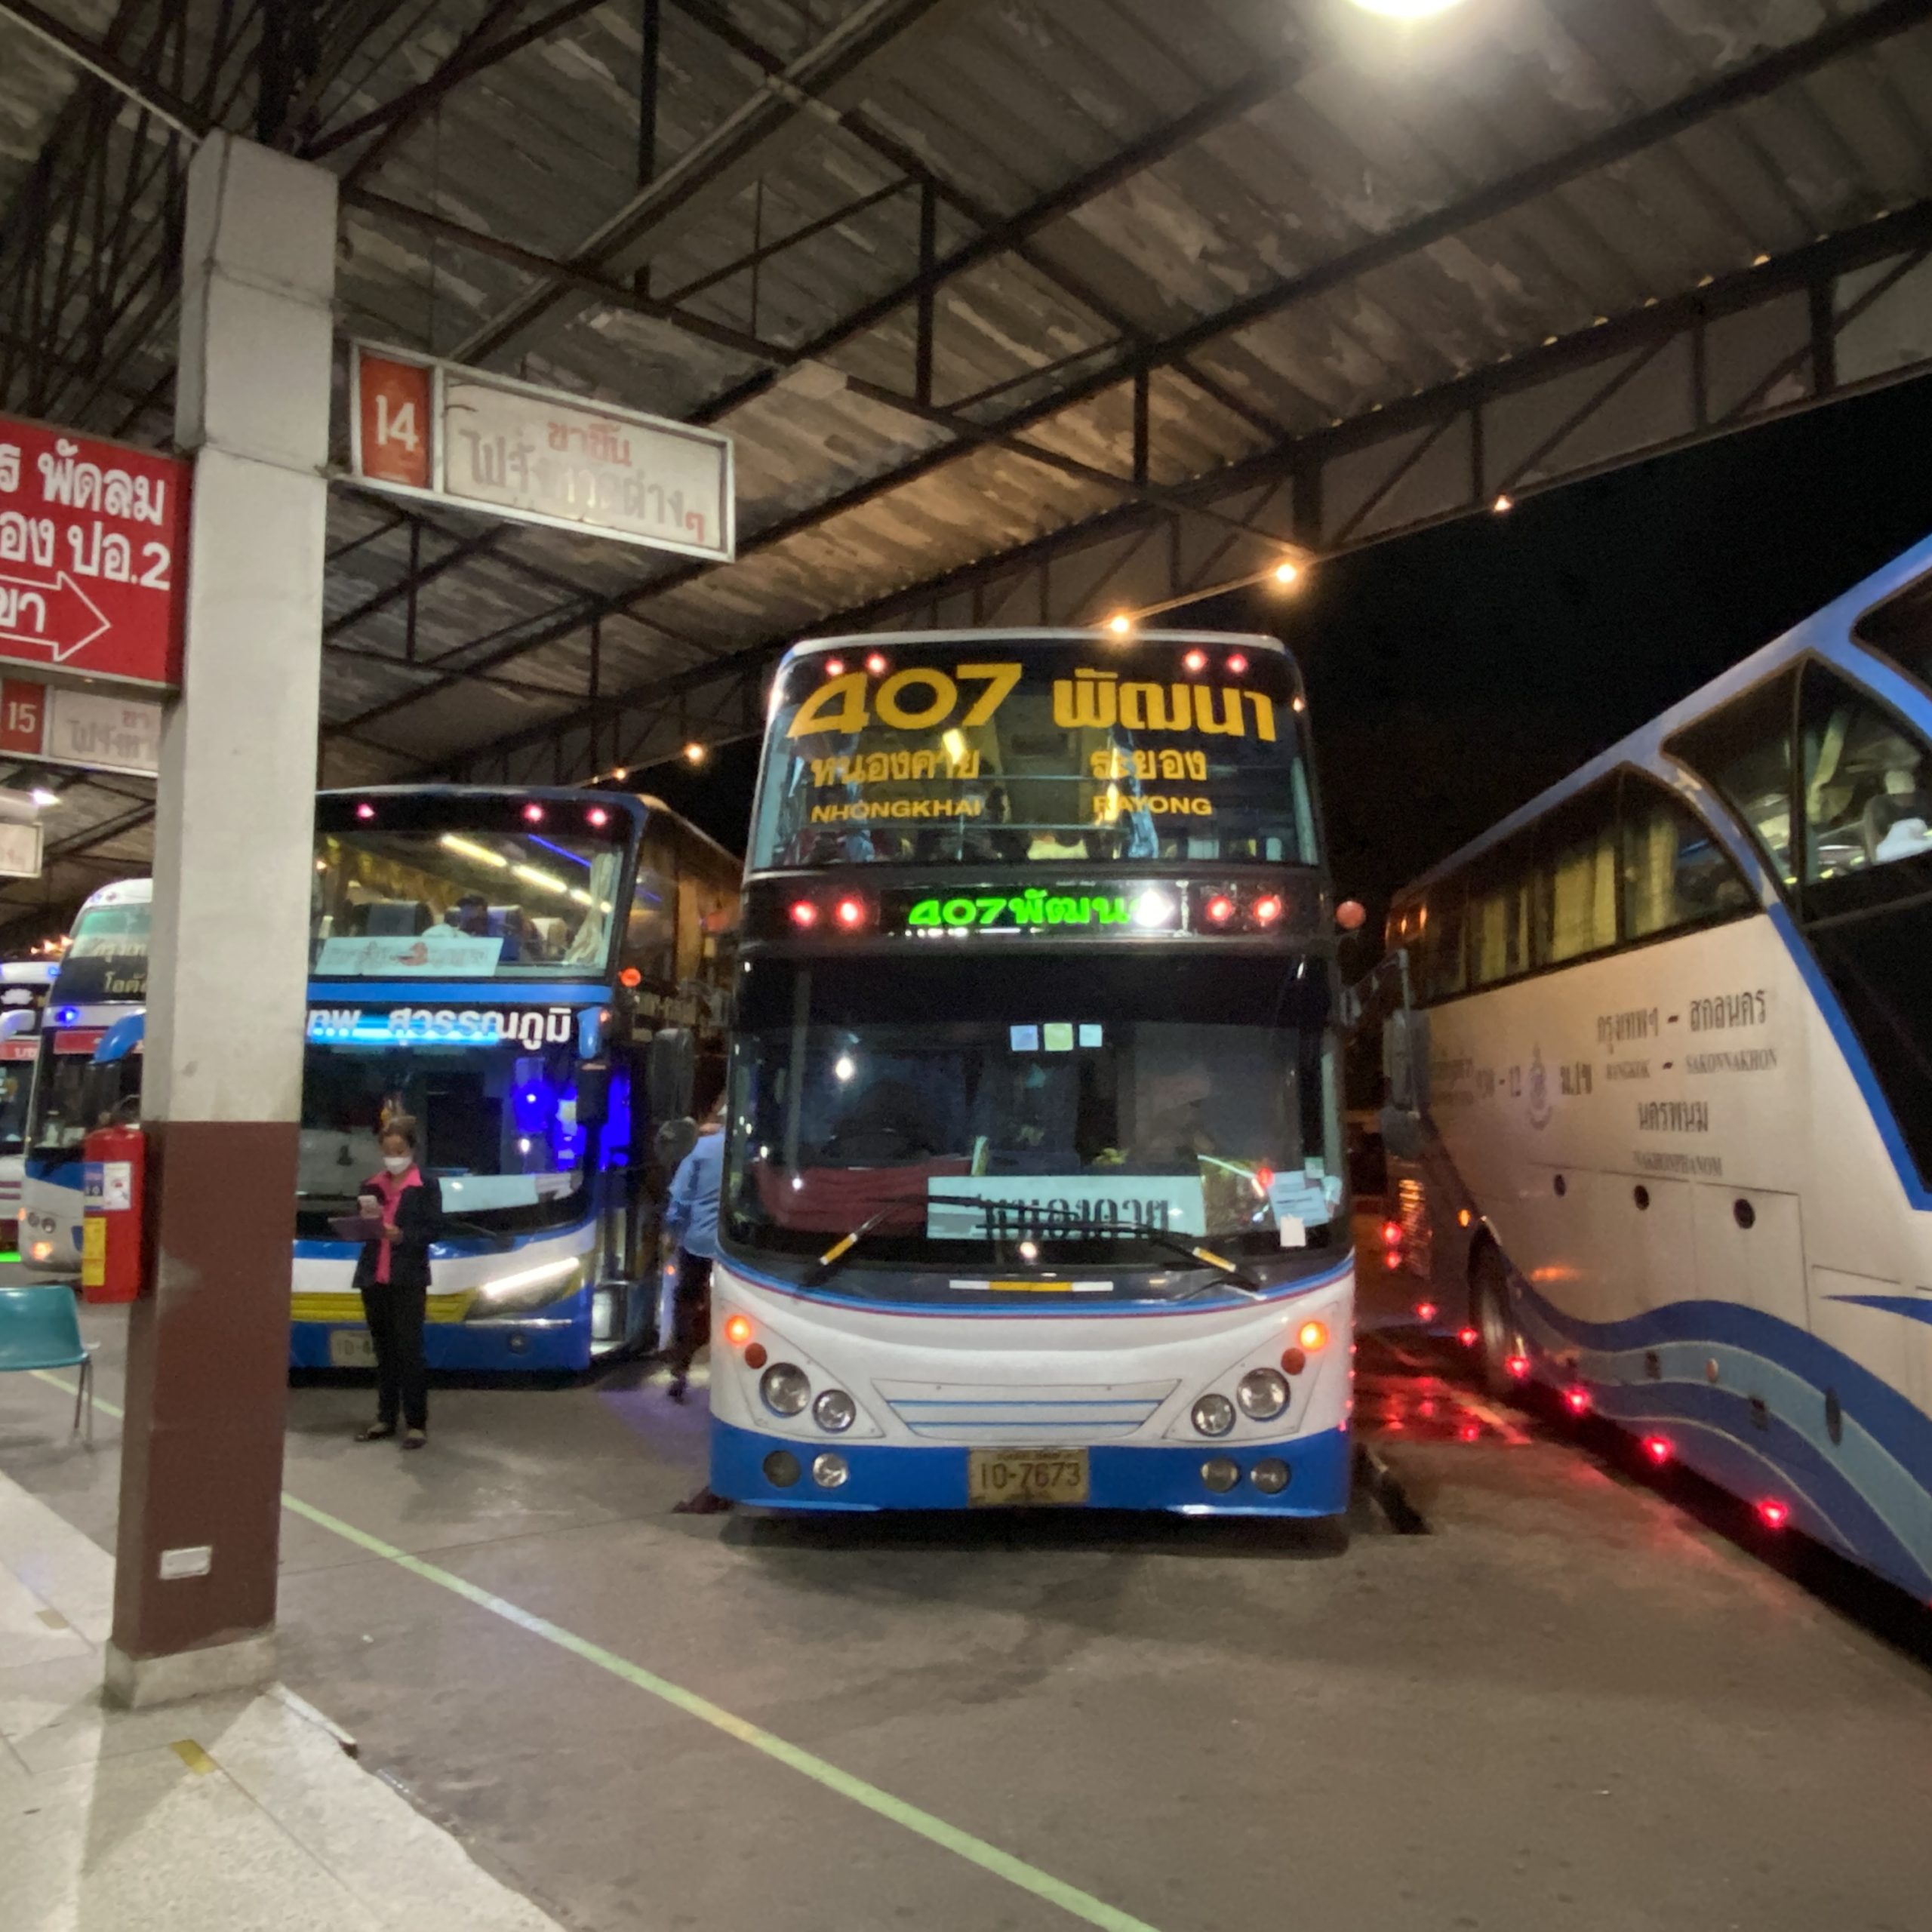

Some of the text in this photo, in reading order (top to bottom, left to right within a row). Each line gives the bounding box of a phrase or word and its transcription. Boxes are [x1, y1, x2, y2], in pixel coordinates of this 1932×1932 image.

[375, 394, 420, 452] 14
[38, 438, 165, 526] พัดลม
[67, 520, 171, 591] ปอ.2
[8, 701, 37, 734] 15
[785, 663, 1023, 739] 407
[811, 749, 1208, 788] หนองคาย ระยอง
[811, 795, 1213, 823] NHONGKHAI RAYONG
[908, 888, 1141, 926] 407พัฒน
[1690, 989, 1767, 1032] สกลนคร
[981, 1461, 1081, 1490] 10-7673
